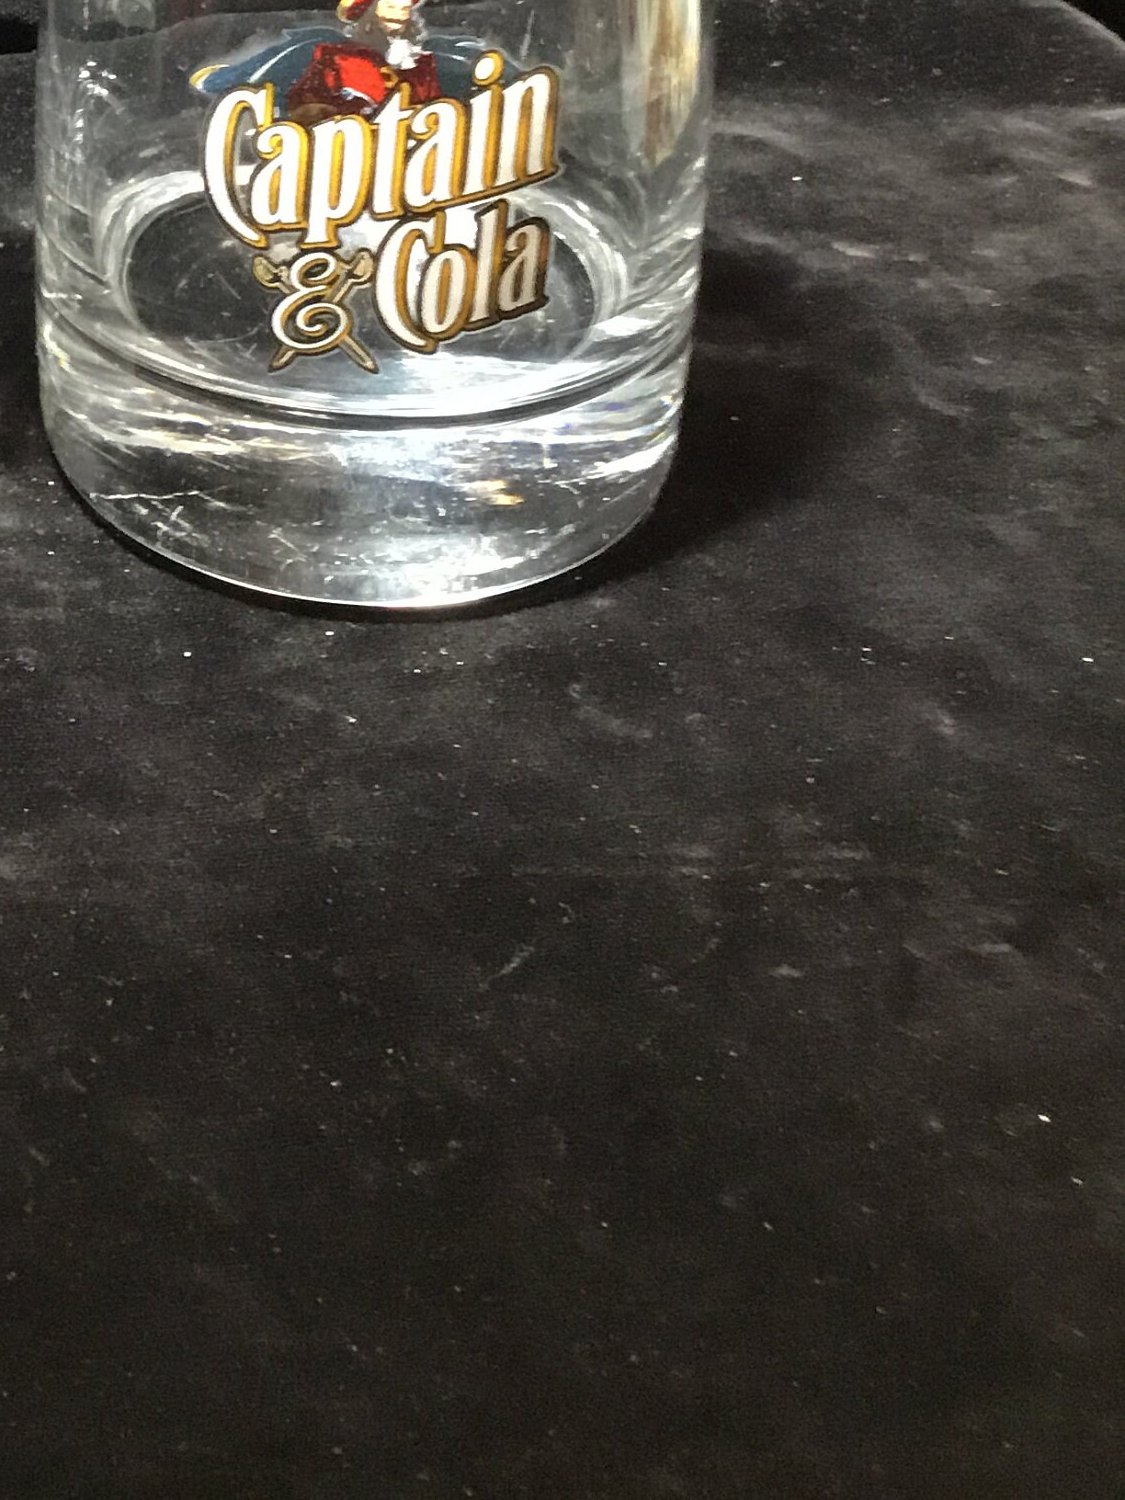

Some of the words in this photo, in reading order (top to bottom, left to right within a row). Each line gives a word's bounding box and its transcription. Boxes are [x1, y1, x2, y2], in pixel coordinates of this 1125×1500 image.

[204, 51, 562, 248] Captain
[269, 250, 354, 356] &
[374, 199, 549, 355] Cola
